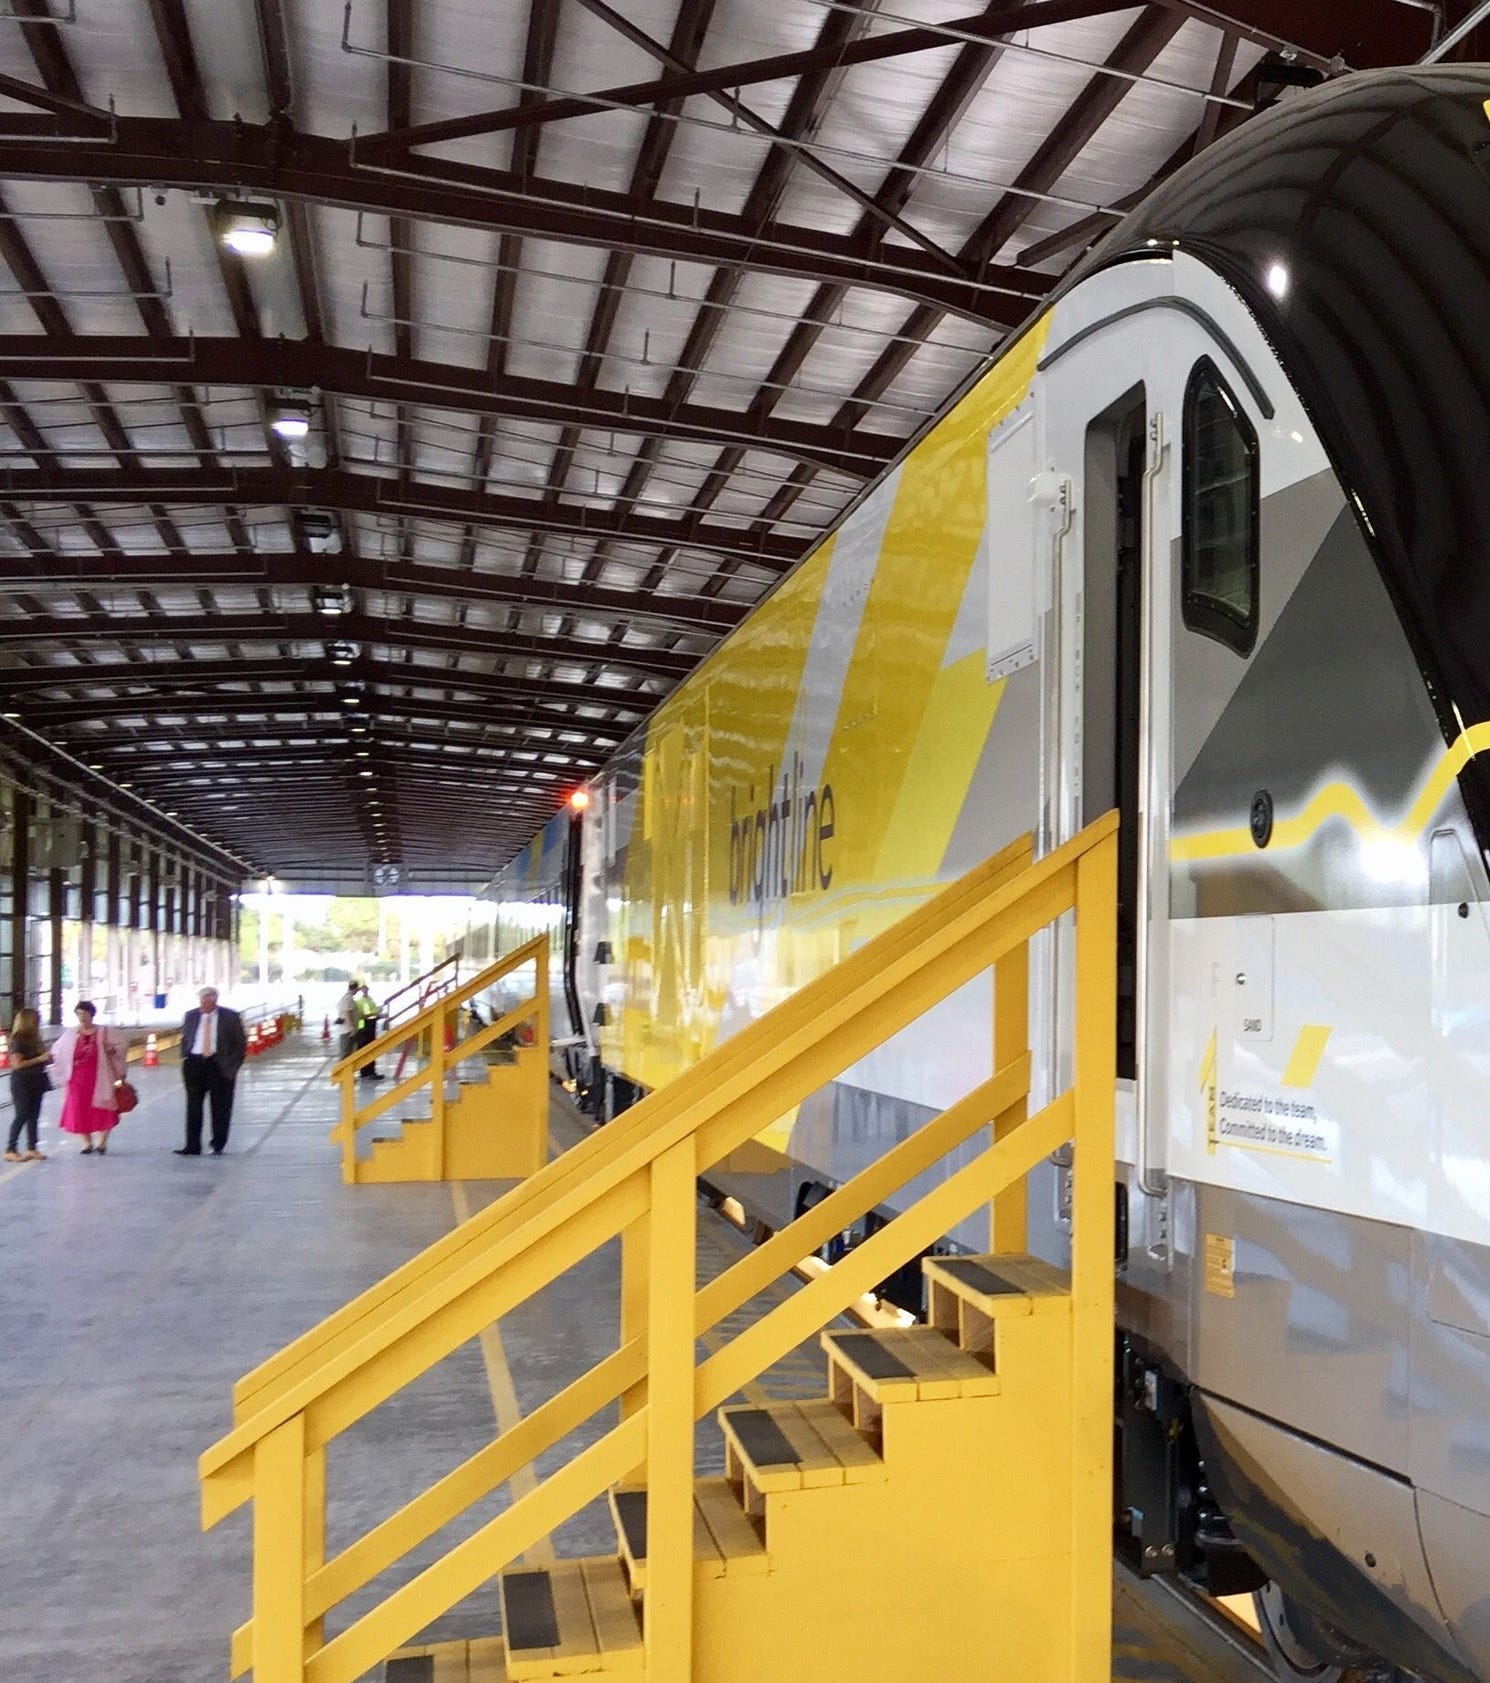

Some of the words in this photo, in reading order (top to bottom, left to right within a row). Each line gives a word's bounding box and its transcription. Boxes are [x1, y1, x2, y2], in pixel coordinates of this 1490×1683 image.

[729, 750, 835, 957] brightline
[1219, 1091, 1263, 1113] Dedicated
[1264, 1096, 1273, 1114] to
[1275, 1097, 1290, 1117] the
[1291, 1101, 1318, 1124] team,
[1219, 1117, 1266, 1142] Committed
[1267, 1123, 1277, 1142] to
[1278, 1125, 1293, 1145] the
[1294, 1128, 1328, 1152] dream.
